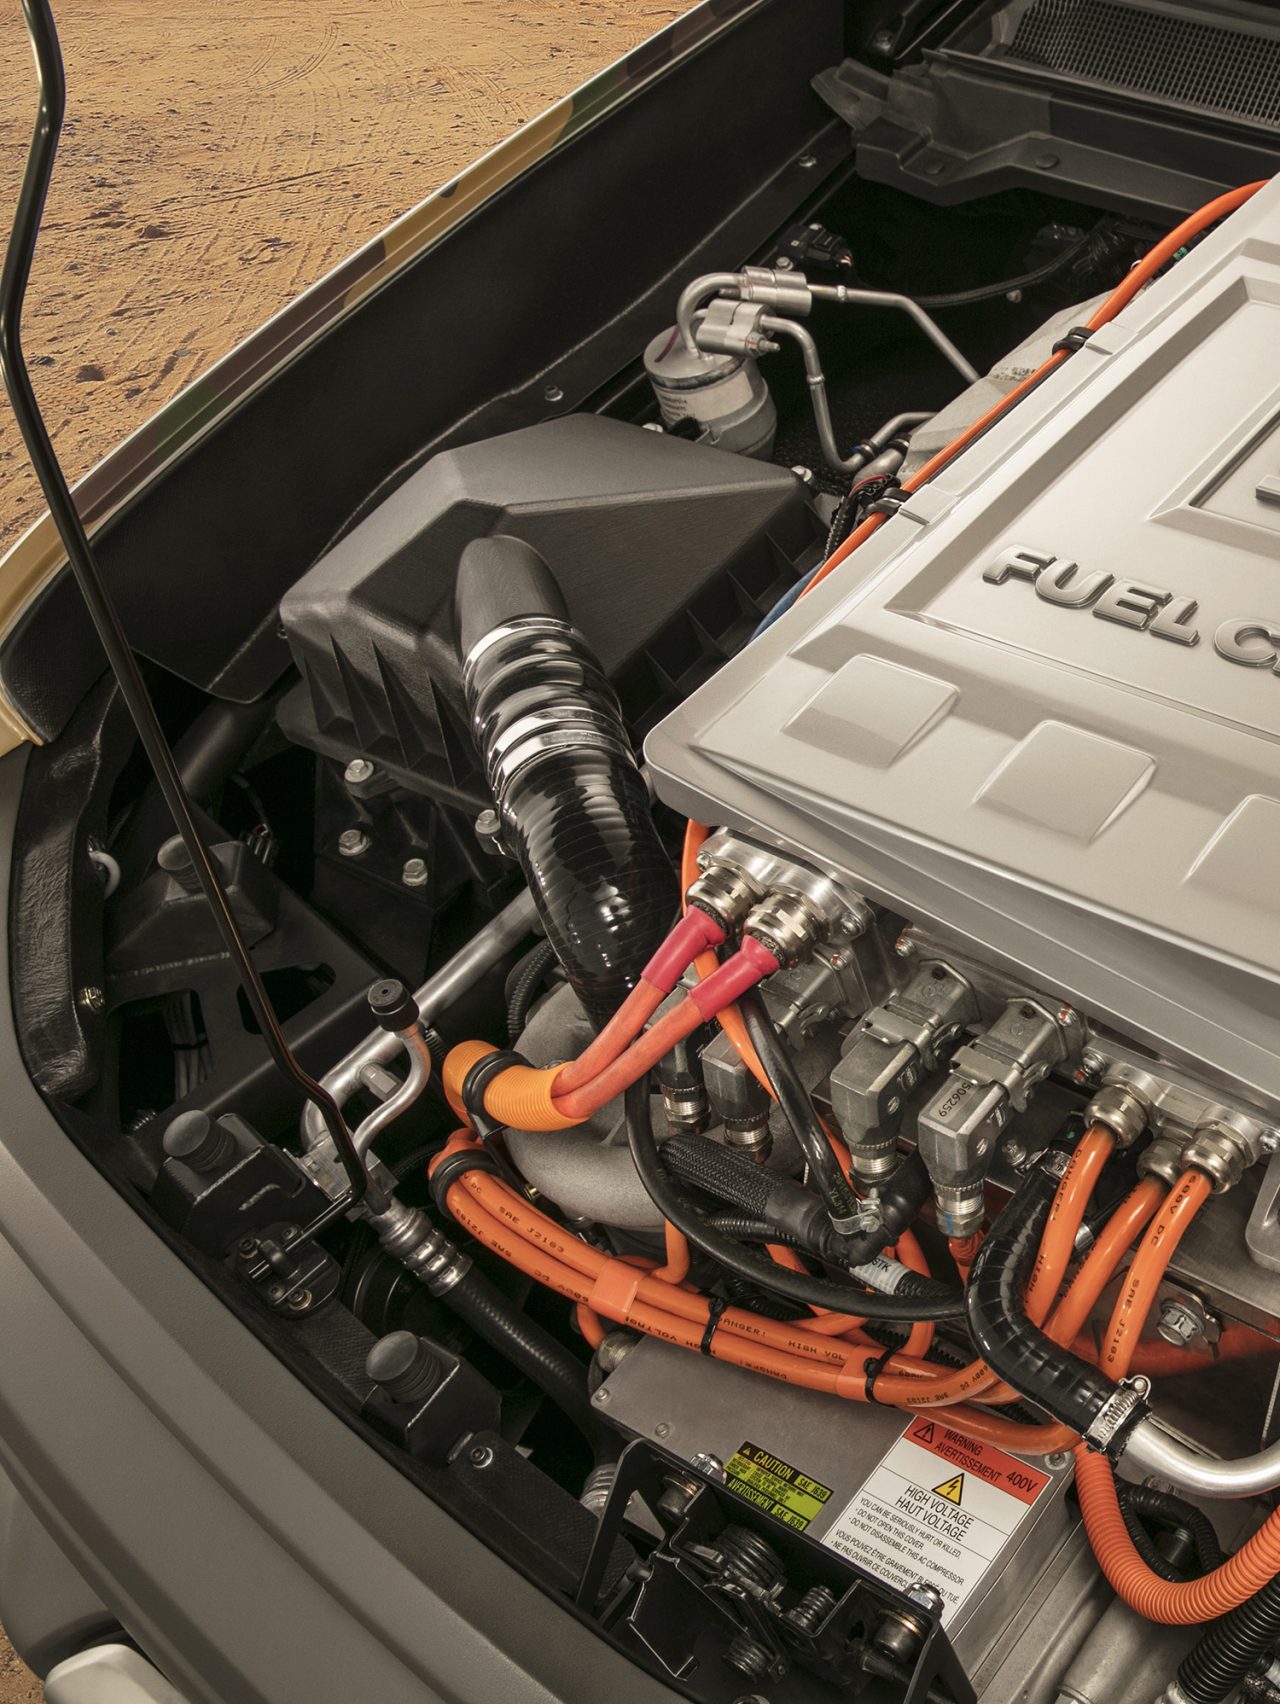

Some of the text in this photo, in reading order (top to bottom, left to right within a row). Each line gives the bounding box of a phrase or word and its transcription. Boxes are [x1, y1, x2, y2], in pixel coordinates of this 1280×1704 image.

[982, 542, 1200, 646] FUEL
[937, 1081, 973, 1118] 506259
[1169, 1175, 1196, 1214] 600V
[470, 1181, 483, 1194] DC
[497, 1205, 520, 1224] SAE
[526, 1226, 565, 1253] J2183
[1150, 1224, 1164, 1246] DC
[489, 1238, 512, 1257] SAE
[1124, 1278, 1139, 1308] SAE
[787, 1339, 817, 1354] HIGH
[823, 1349, 847, 1362] VOL
[944, 1428, 984, 1456] WARNING
[752, 1450, 794, 1480] CAUTION
[797, 1477, 811, 1489] SAE
[934, 1441, 1038, 1492] AVERTISSEMENT 400V
[726, 1478, 774, 1510] AVERTISSEMENT
[774, 1507, 788, 1519] SAE
[894, 1495, 966, 1541] HAUT VOLTAGE
[904, 1484, 974, 1529] HIGH VOLTAGE
[849, 1517, 860, 1526] DO
[858, 1522, 872, 1533] NOT
[869, 1528, 907, 1553] DISASSEMBLE
[905, 1548, 919, 1559] THIS
[917, 1555, 927, 1564] AC
[856, 1508, 866, 1517] DO
[863, 1512, 878, 1524] NOT
[876, 1519, 893, 1532] OPEN
[891, 1527, 905, 1539] THIS
[859, 1496, 873, 1507] YOU
[870, 1503, 884, 1514] CAN
[881, 1509, 891, 1518] BE
[889, 1513, 919, 1534] SERIOUSLY
[917, 1529, 934, 1542] HURT
[932, 1538, 943, 1547] OR
[832, 1541, 910, 1588] NE PAS OUVRIR CE COUVERCL
[835, 1529, 851, 1541] VOUS
[849, 1537, 872, 1553] POUVEZ
[884, 1557, 918, 1580] GRAVEMENT
